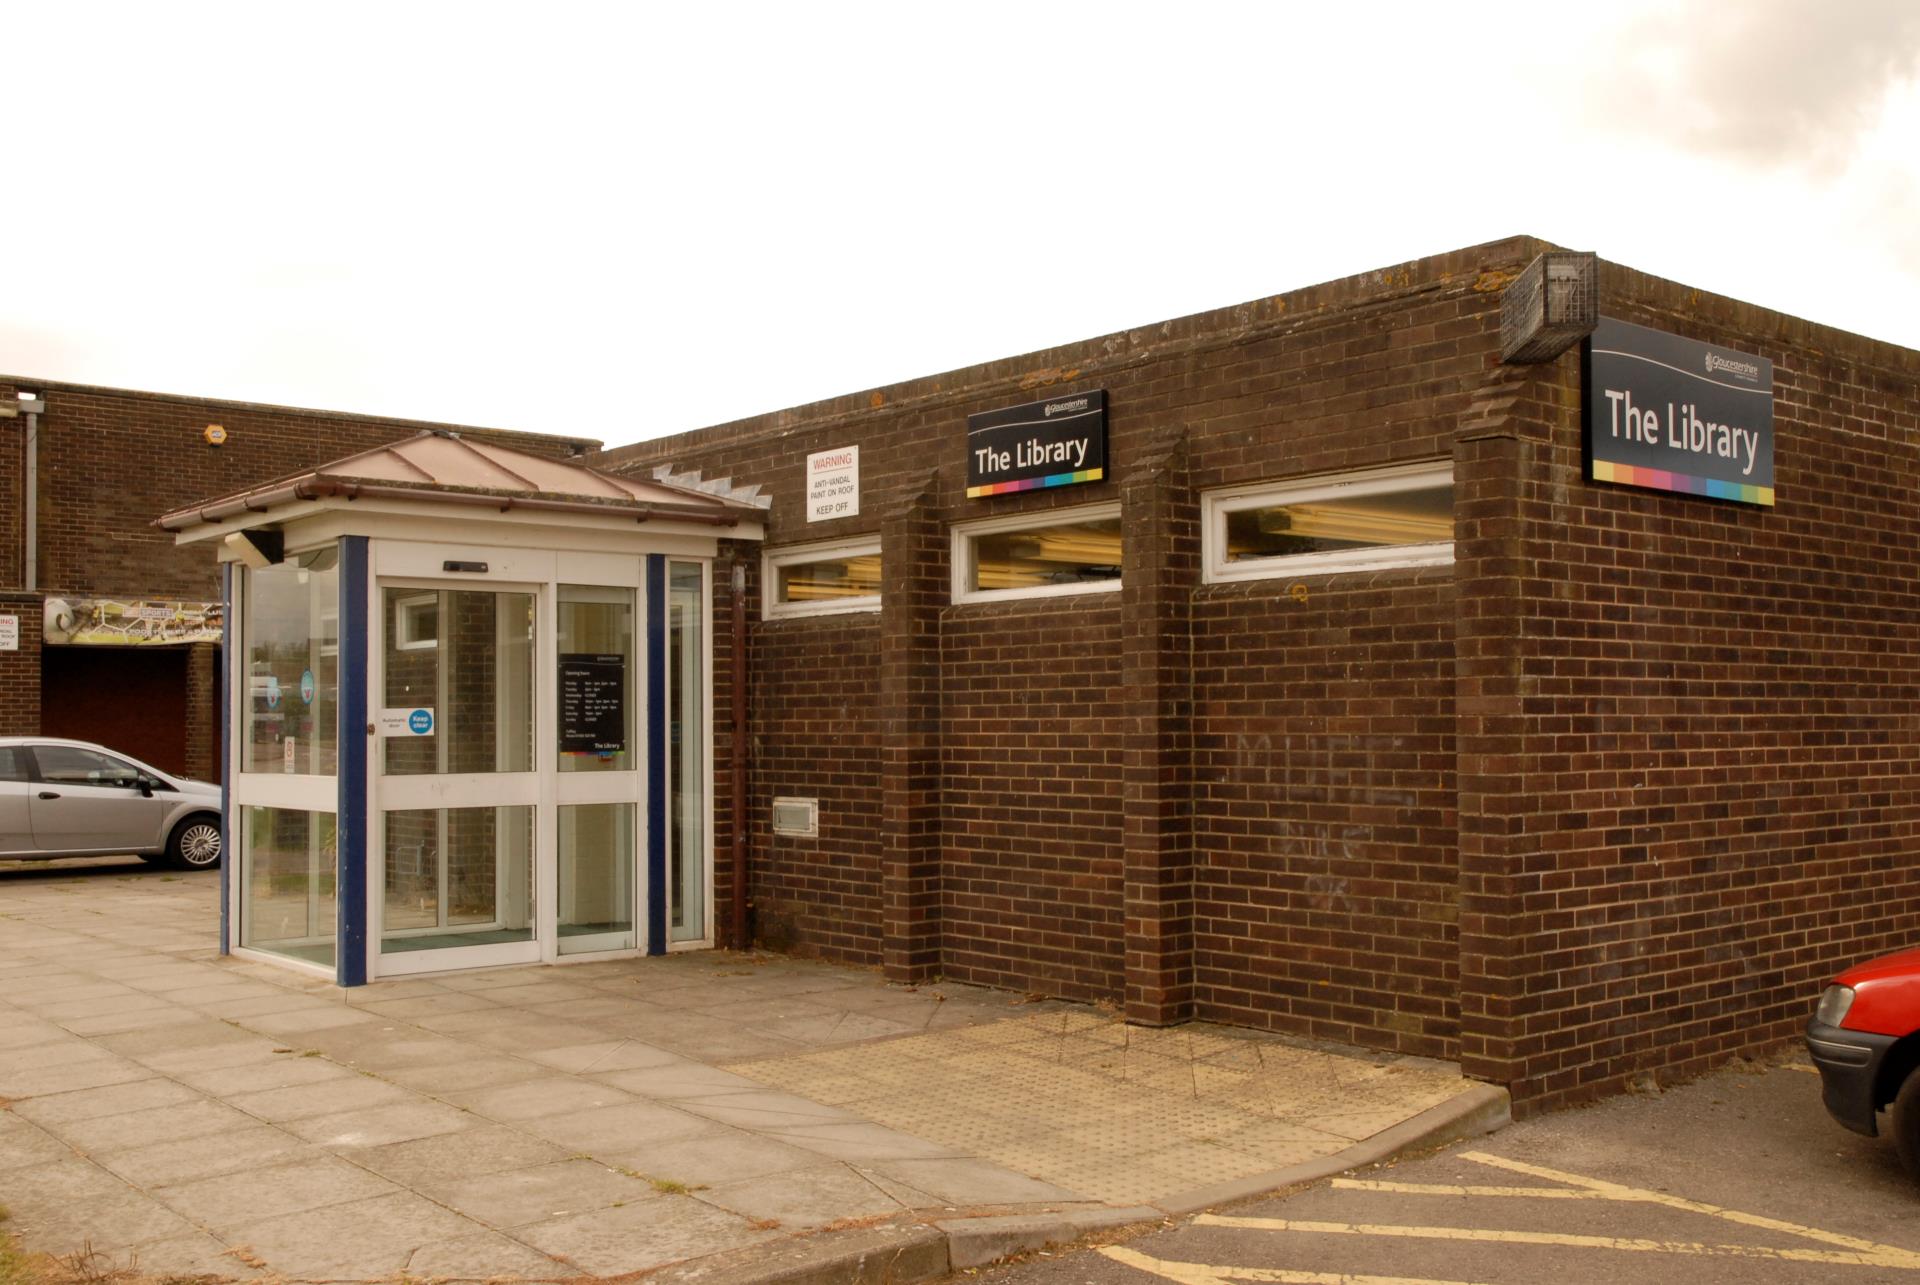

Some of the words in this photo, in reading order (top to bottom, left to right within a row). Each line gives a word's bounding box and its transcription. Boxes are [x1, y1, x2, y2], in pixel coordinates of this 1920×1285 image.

[1604, 389, 1659, 445] The
[1667, 402, 1759, 476] Library
[813, 453, 852, 470] WARNING
[975, 445, 1011, 474] The
[1016, 438, 1088, 468] Library
[814, 475, 850, 488] ANTI-VANDAL
[810, 490, 827, 500] PAINT
[827, 488, 837, 497] ON
[838, 485, 854, 495] ROOF
[816, 504, 834, 515] KEEP
[835, 502, 848, 512] OFF
